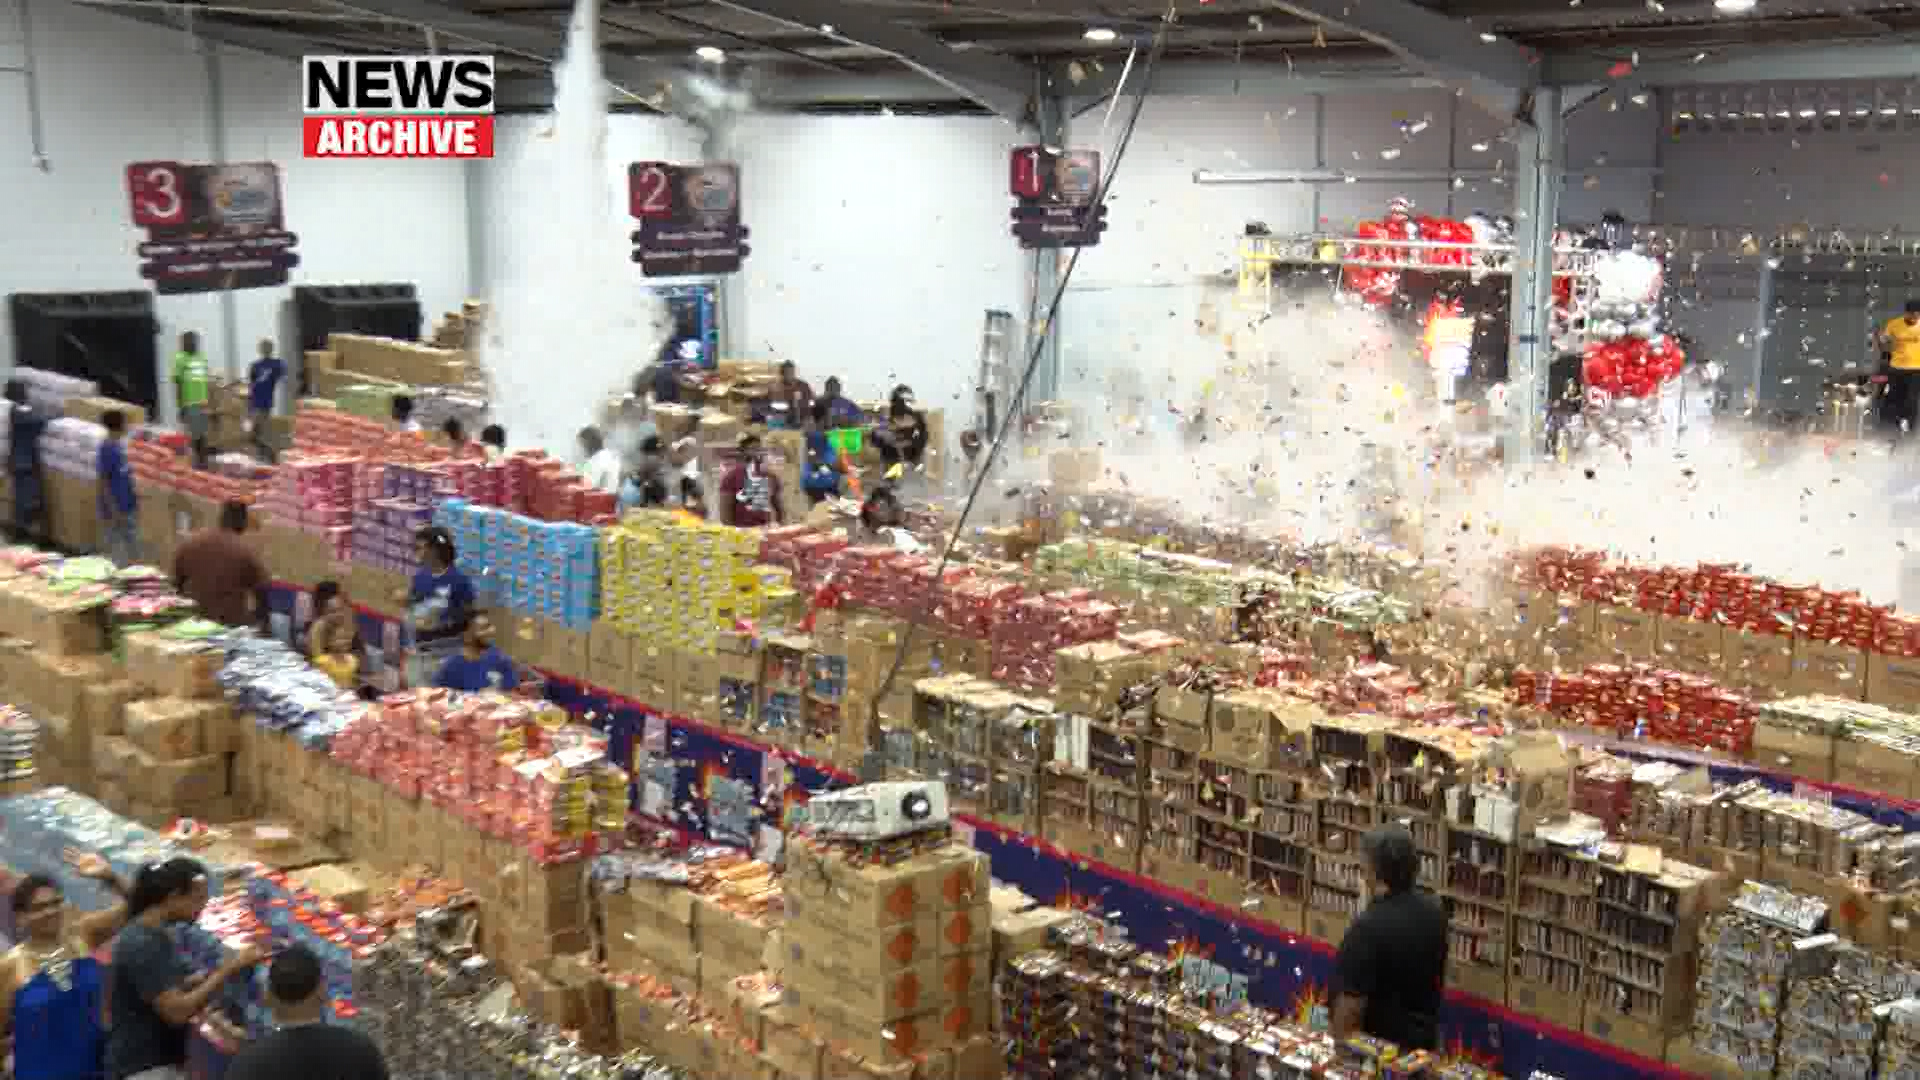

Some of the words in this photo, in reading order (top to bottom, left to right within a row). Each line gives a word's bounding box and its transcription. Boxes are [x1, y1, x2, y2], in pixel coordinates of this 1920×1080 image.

[144, 166, 181, 218] 3
[640, 166, 666, 212] 2
[1026, 151, 1040, 192] 1
